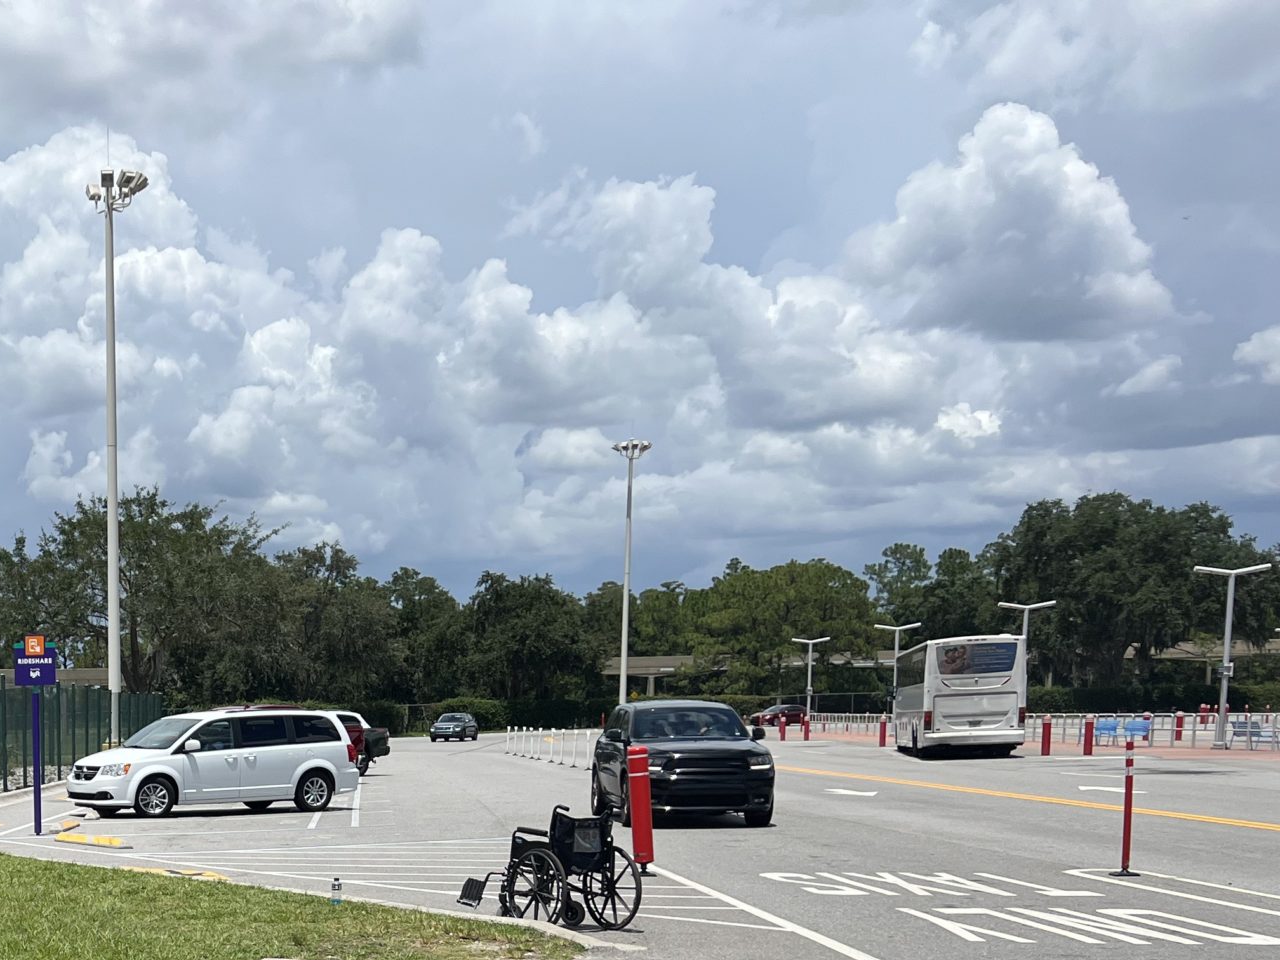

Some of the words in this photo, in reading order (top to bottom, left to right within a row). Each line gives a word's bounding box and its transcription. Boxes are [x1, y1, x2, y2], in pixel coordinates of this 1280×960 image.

[17, 657, 53, 665] RIDESHARE
[758, 871, 1107, 897] TAXIS
[894, 907, 1280, 945] ONLY
